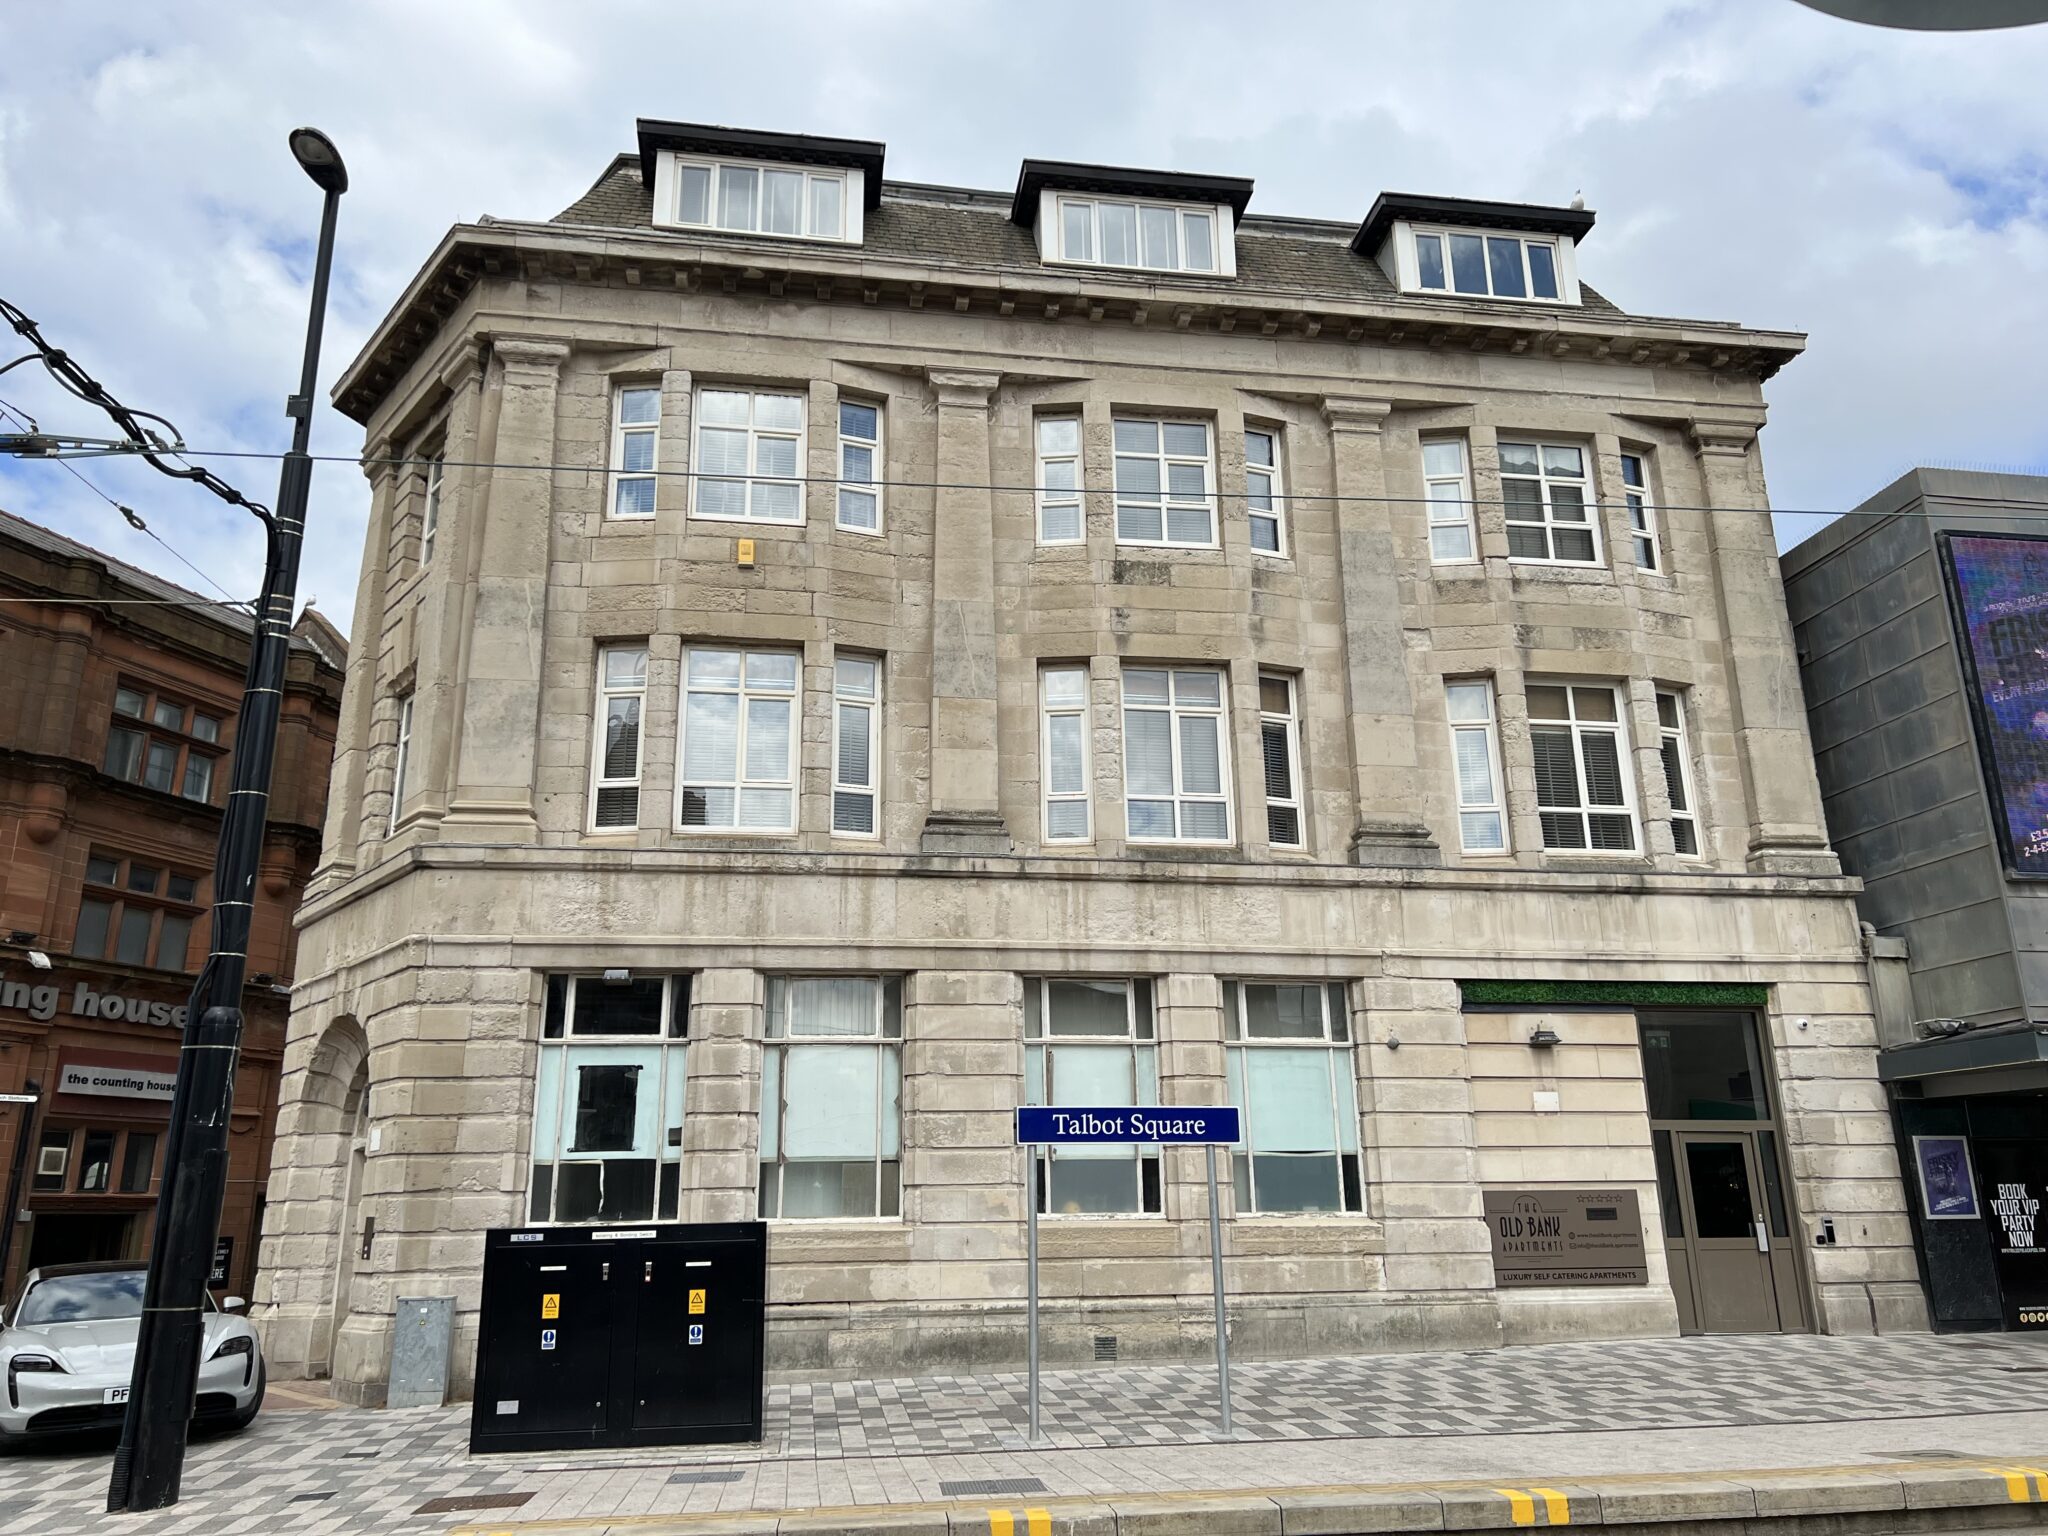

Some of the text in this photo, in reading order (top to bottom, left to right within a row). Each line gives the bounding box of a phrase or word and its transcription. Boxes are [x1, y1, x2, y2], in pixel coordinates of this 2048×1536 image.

[68, 1074, 89, 1085] the
[92, 1077, 144, 1091] counting
[1052, 1113, 1206, 1140] Talbot Square
[1997, 1183, 2029, 1200] BOOK
[1517, 1202, 1537, 1213] THE
[1990, 1199, 2040, 1216] YOUR VIP
[1500, 1216, 1561, 1238] OLD BANK
[2000, 1215, 2035, 1231] PARTY
[1502, 1240, 1564, 1252] APARTMENTS
[2008, 1231, 2034, 1247] NOW
[1503, 1273, 1531, 1281] LUXURY
[1552, 1272, 1588, 1280] CATERING
[1589, 1271, 1637, 1280] APARTMENTS
